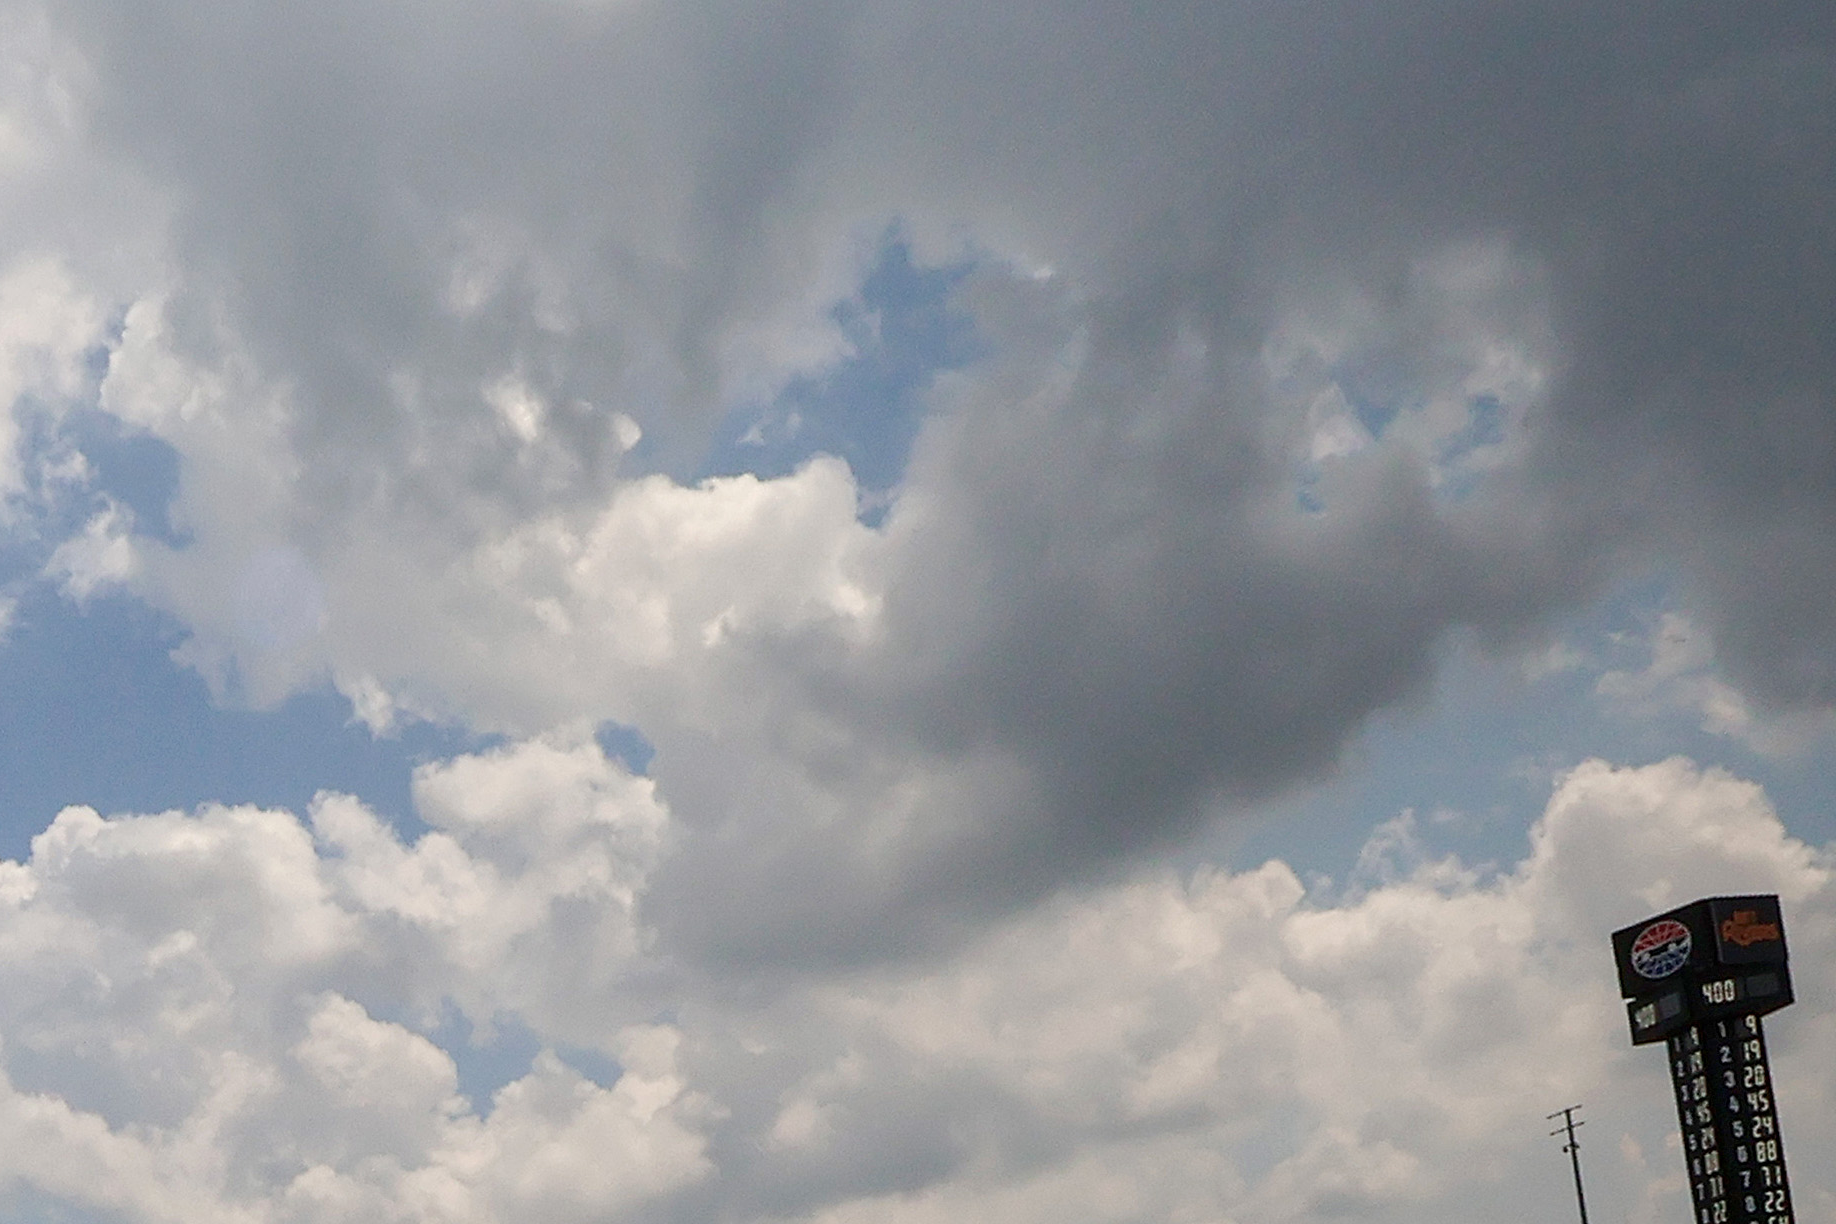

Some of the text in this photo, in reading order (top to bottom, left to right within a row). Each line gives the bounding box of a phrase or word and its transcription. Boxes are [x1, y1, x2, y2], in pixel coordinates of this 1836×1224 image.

[1702, 979, 1735, 1004] 400
[1717, 1014, 1757, 1038] 1 9
[1720, 1039, 1761, 1063] 2 19
[1723, 1064, 1765, 1088] 3 20
[1728, 1089, 1769, 1113] 4 45
[1732, 1115, 1774, 1138] 5 24
[1739, 1166, 1782, 1188] 7 71
[1765, 1190, 1785, 1213] 22
